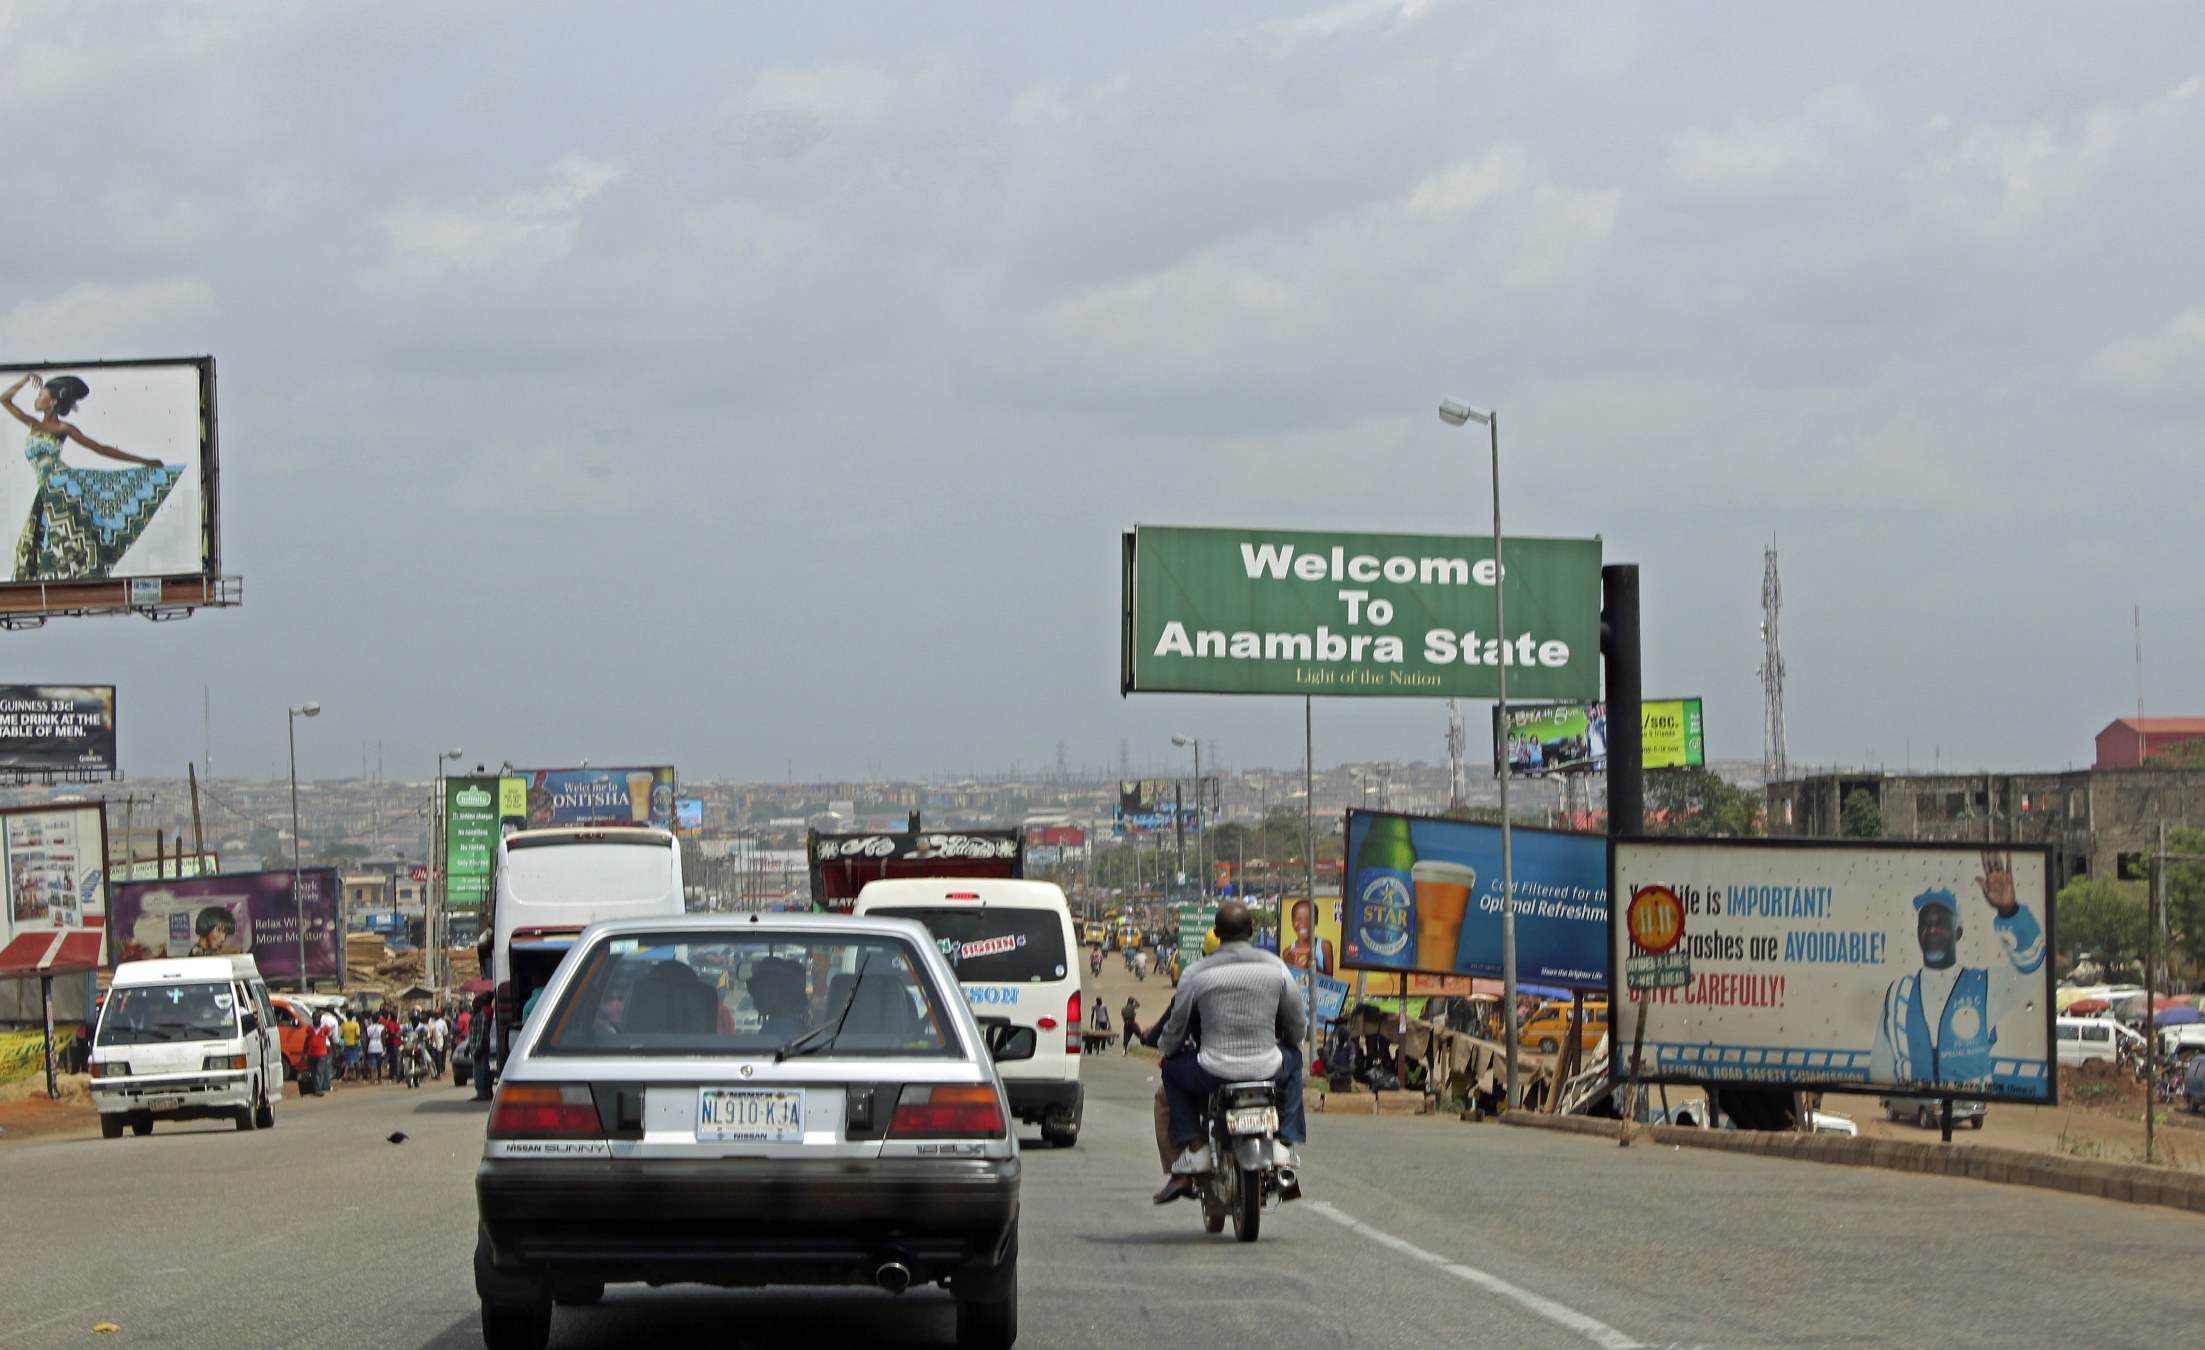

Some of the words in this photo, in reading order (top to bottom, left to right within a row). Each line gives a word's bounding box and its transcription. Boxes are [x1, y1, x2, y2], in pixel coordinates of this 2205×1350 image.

[1240, 542, 1505, 586] Welcome
[1339, 589, 1394, 626] To
[1153, 620, 1404, 663] Anambra
[1423, 628, 1570, 667] State
[1296, 667, 1334, 686] Light
[1341, 668, 1357, 684] of
[1360, 669, 1384, 685] the
[1390, 669, 1442, 686] Nation
[0, 699, 48, 712] GUINNESS
[20, 713, 59, 726] DRINK
[60, 713, 75, 725] AT
[77, 713, 100, 726] THE
[35, 725, 53, 737] OF
[55, 725, 87, 737] MEN.
[564, 782, 607, 793] Welcme
[553, 791, 630, 808] ONITSHA
[1521, 880, 1569, 899] Filtered
[1573, 885, 1591, 900] for
[1479, 894, 1536, 915] Optmal
[1706, 885, 1721, 915] is
[1727, 884, 1832, 918] IMPORTANT!
[255, 918, 281, 930] Relax
[1363, 904, 1408, 928] STAR
[256, 933, 283, 944] More
[1750, 935, 1778, 961] are
[1784, 930, 1886, 965] AVOIDABLE!
[1684, 971, 1786, 1008] CAREFULLY!
[1661, 1063, 1711, 1079] FEDERAL
[1713, 1066, 1743, 1080] ROAD
[1746, 1068, 1787, 1081] SAFETY
[1790, 1069, 1865, 1083] COMMISSION
[734, 1132, 767, 1140] NISSAN
[506, 1144, 541, 1152] NISSAN
[544, 1144, 605, 1153] SUNNY
